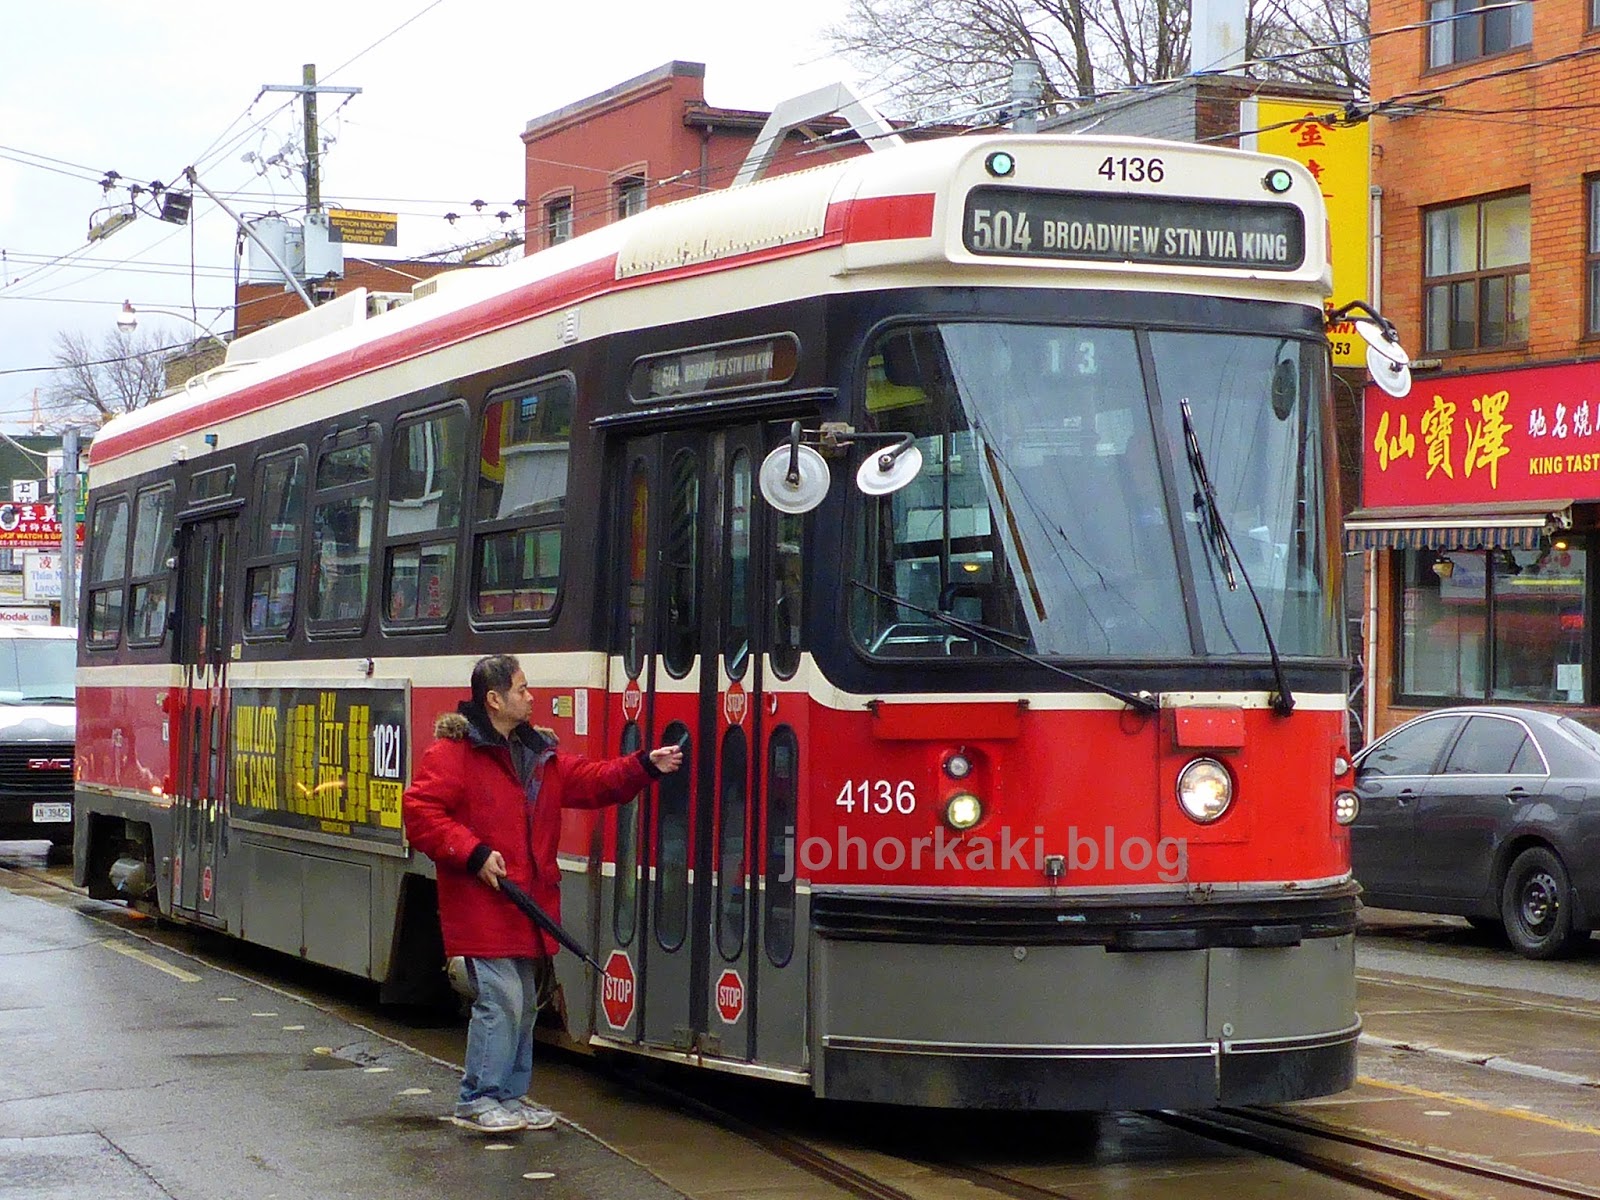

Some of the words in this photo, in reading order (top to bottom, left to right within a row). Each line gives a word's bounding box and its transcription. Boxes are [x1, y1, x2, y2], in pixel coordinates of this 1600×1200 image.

[1098, 157, 1165, 183] 4136
[973, 208, 1031, 251] 504
[1043, 220, 1160, 254] BROADVIEW
[1164, 228, 1202, 257] STN
[1207, 231, 1238, 259] VIA
[1242, 233, 1288, 261] KING
[1528, 400, 1600, 439] 馳名燒
[1529, 456, 1563, 475] KING
[1566, 453, 1600, 473] TAST
[0, 613, 29, 621] Kodak
[254, 706, 277, 754] LOTS
[236, 753, 248, 806] OF
[250, 755, 277, 810] CASH
[836, 780, 916, 814] 4136
[605, 977, 632, 1003] STOP
[719, 985, 741, 1008] STOP
